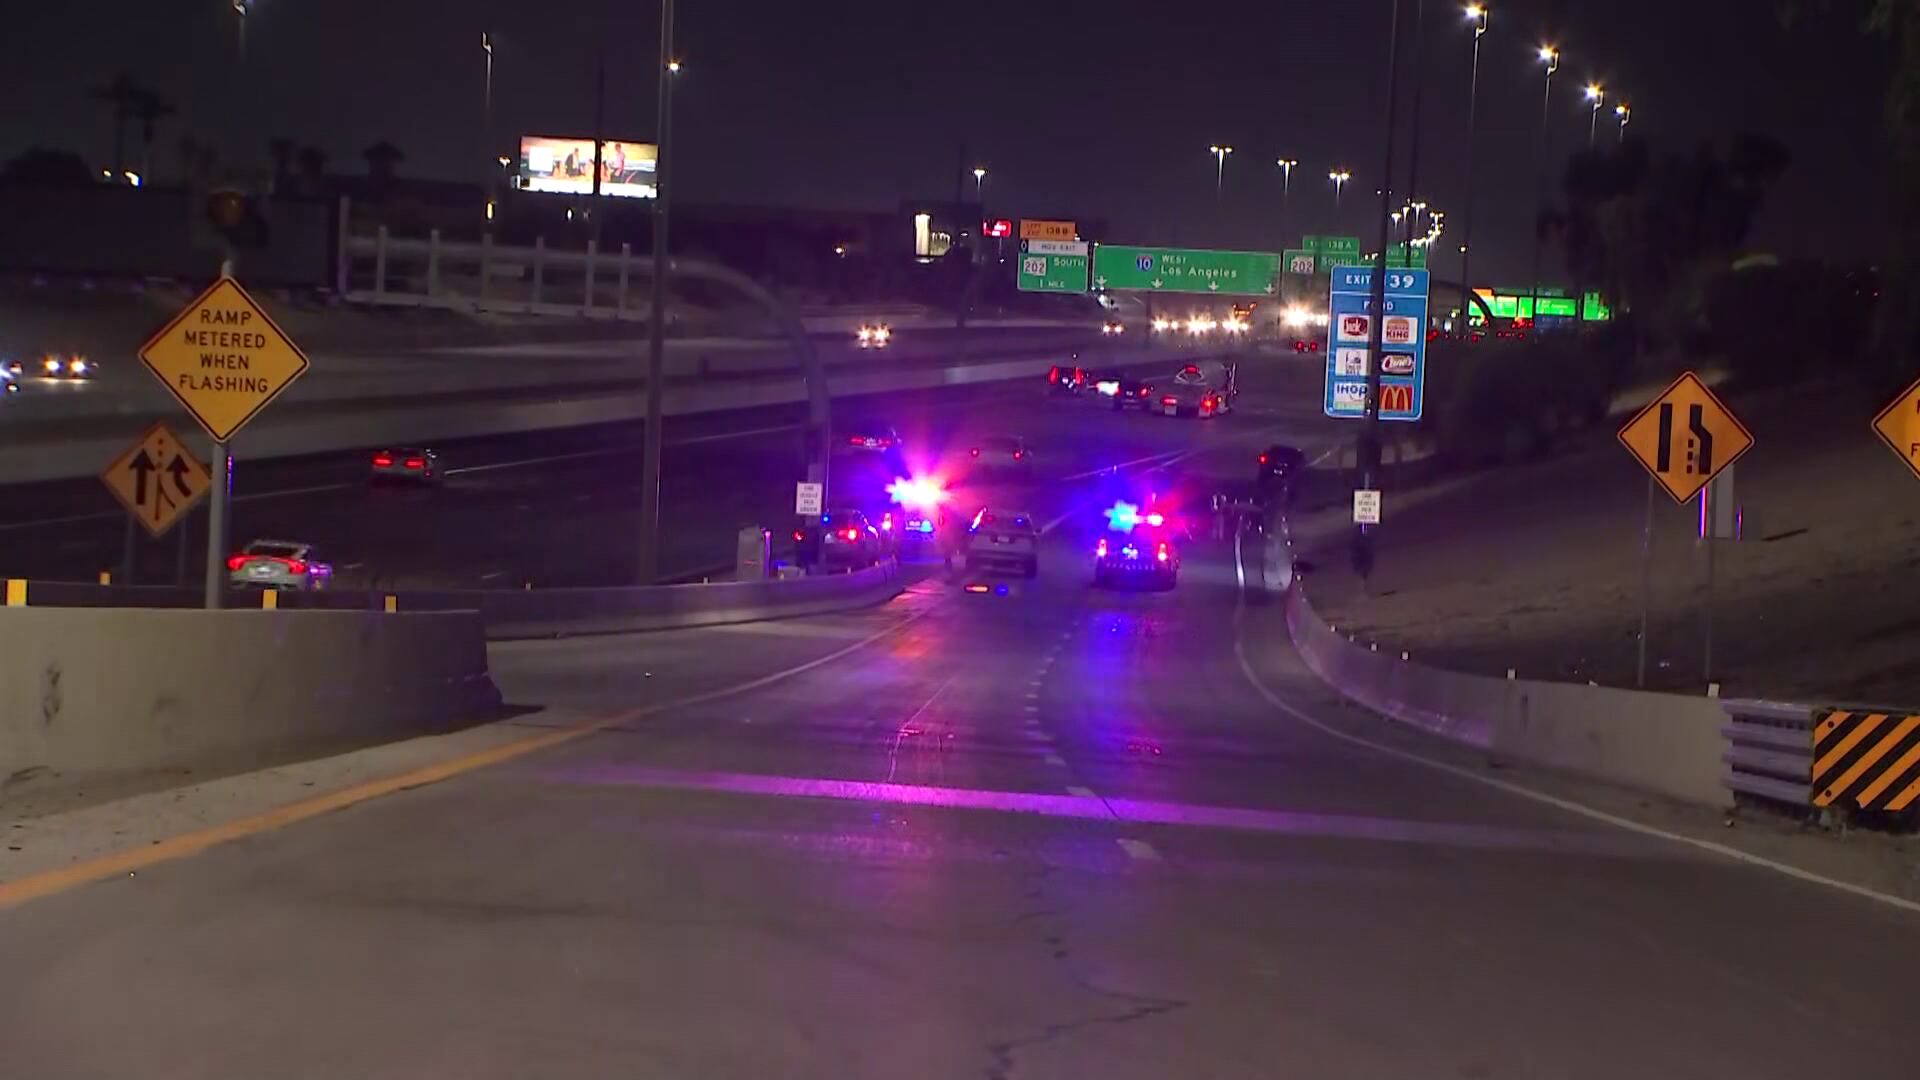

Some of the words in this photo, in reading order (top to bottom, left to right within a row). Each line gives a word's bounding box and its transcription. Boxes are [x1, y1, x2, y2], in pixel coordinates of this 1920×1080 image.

[1053, 256, 1085, 267] SOUTH
[1138, 259, 1152, 270] 10
[1161, 254, 1186, 265] WEST
[1024, 261, 1045, 274] 202
[1160, 265, 1182, 275] Los
[1188, 266, 1238, 279] Angeles
[1292, 260, 1313, 272] 202
[1345, 274, 1372, 285] EXIT
[200, 308, 252, 326] RAMP
[183, 330, 267, 348] METERED
[1386, 330, 1409, 339] KING
[199, 353, 250, 370] WHEN
[178, 374, 269, 393] FLASHING
